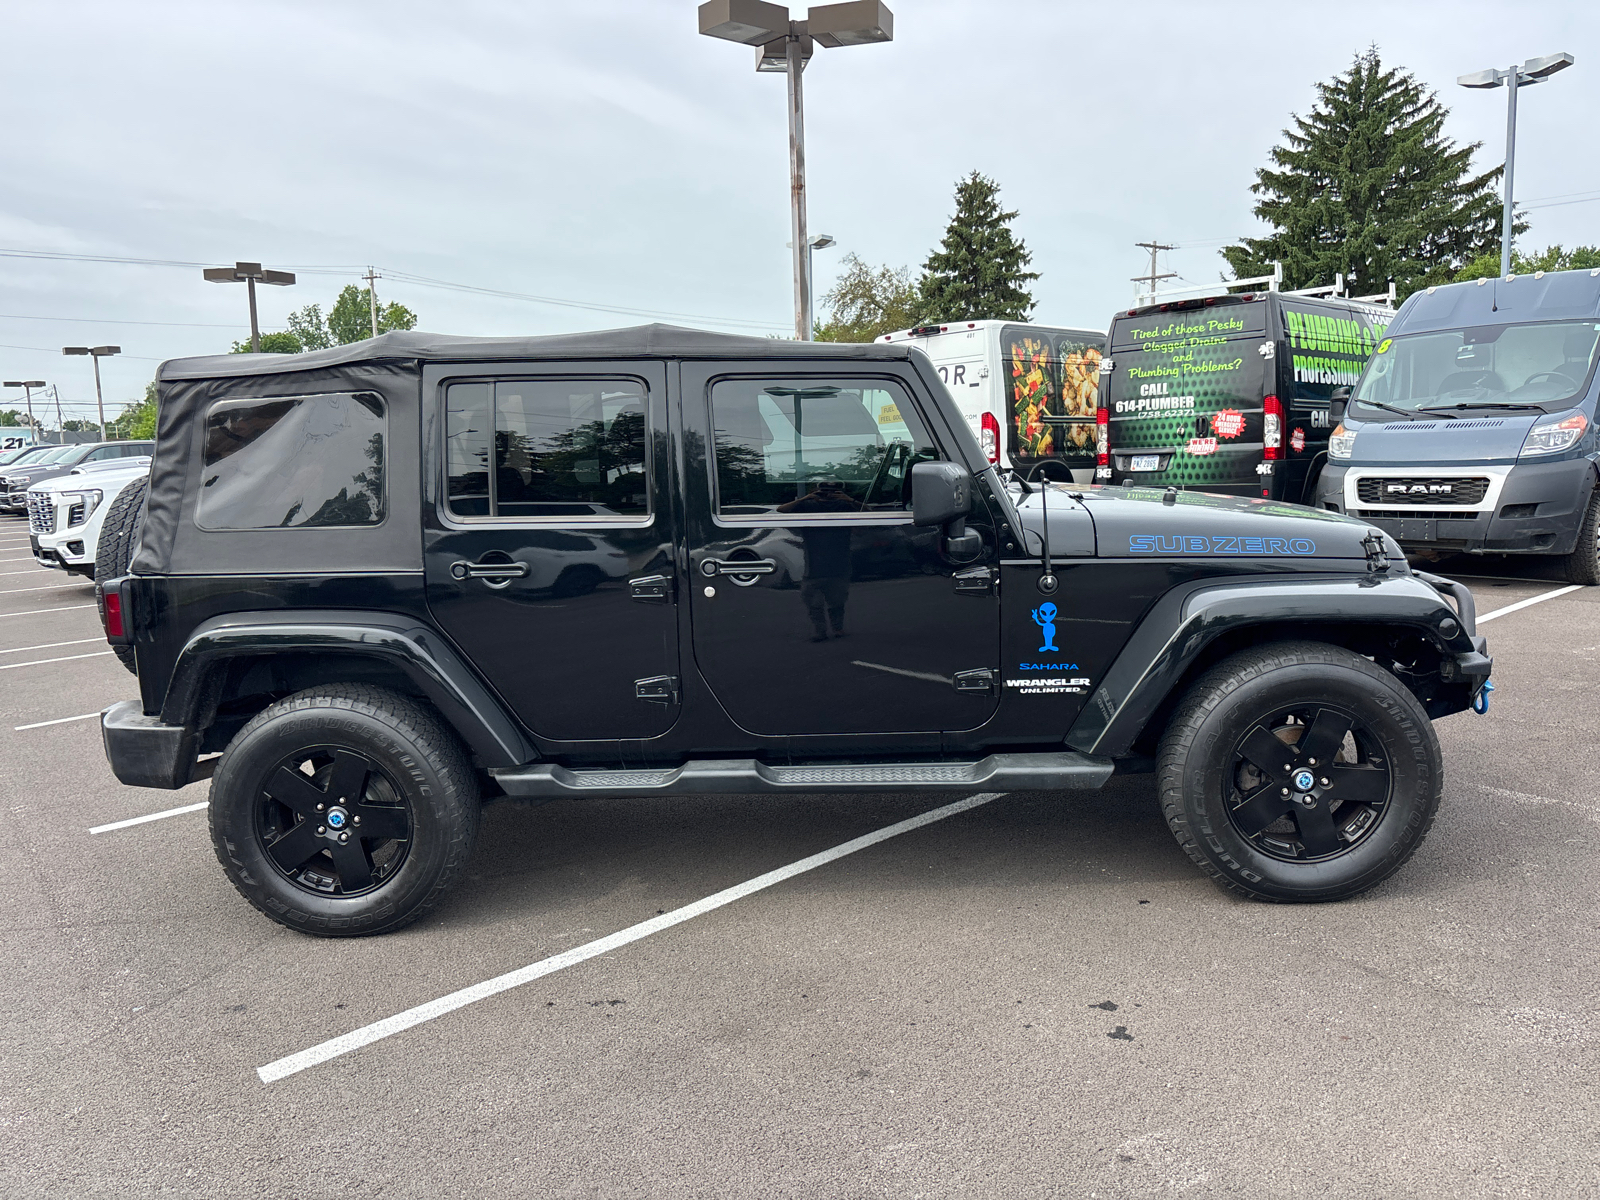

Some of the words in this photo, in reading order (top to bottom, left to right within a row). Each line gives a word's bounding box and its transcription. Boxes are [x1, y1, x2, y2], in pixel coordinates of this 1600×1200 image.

[1130, 327, 1159, 340] Tired
[1161, 324, 1174, 337] of
[1175, 323, 1205, 335] those
[1207, 317, 1244, 331] Pesky
[1287, 311, 1362, 355] PLUMBING
[1363, 327, 1373, 356] &
[1373, 323, 1388, 344] D
[1142, 338, 1187, 353] Clogged
[1189, 336, 1227, 348] Drains
[1173, 351, 1194, 363] and
[1128, 365, 1179, 379] Plumbing
[1181, 358, 1243, 374] Problems?
[1140, 382, 1168, 397] CALL
[1115, 395, 1194, 413] 614-PLUMBER
[1138, 408, 1195, 419] (758-6237)
[1217, 412, 1226, 421] 24
[1226, 414, 1241, 422] HOUR
[1387, 485, 1452, 494] RAM
[1129, 534, 1316, 555] SUBZERO
[1006, 678, 1091, 687] WRANGLER
